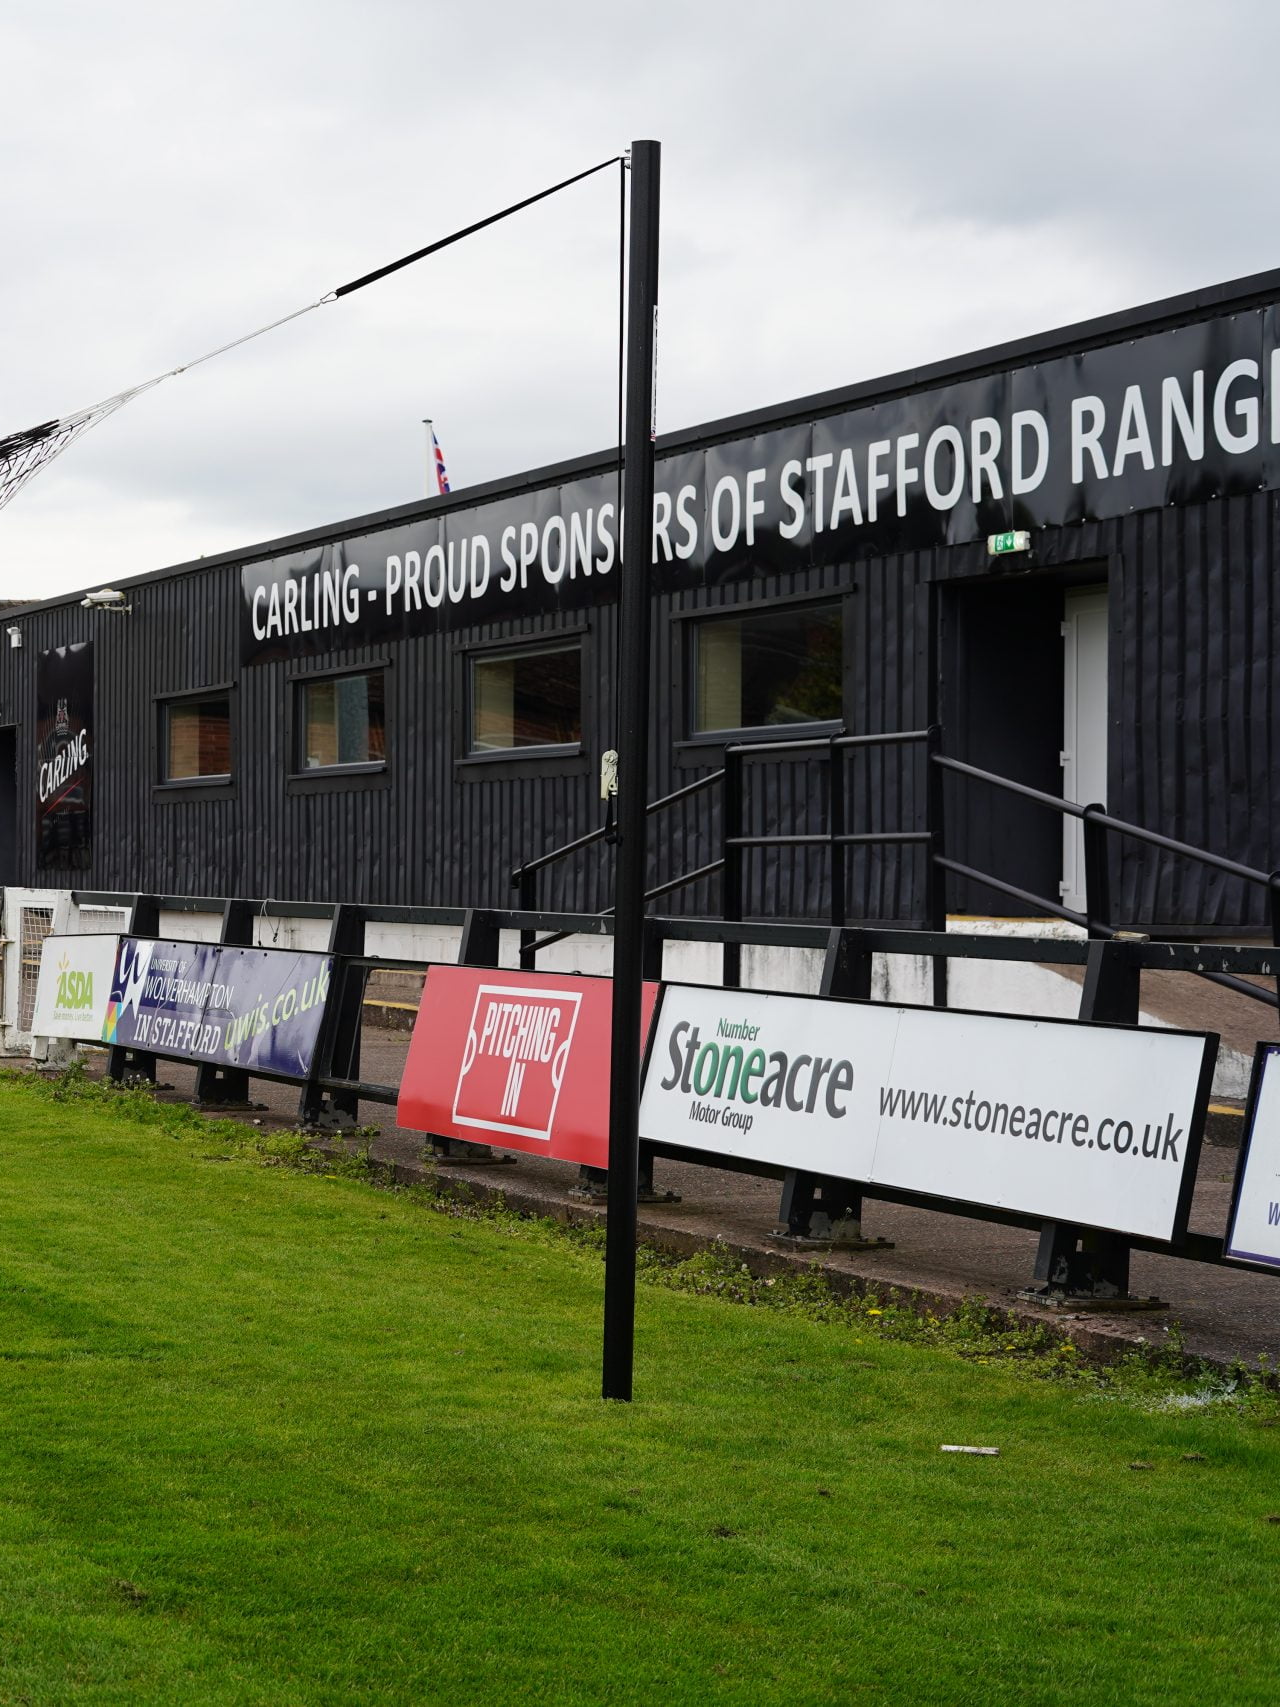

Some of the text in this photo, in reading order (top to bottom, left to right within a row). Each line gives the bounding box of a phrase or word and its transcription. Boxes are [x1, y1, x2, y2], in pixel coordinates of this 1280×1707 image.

[252, 564, 360, 641] CARLING
[368, 590, 376, 601] -
[386, 534, 491, 615] PROUD
[500, 484, 698, 593] SPONSRS
[711, 467, 766, 551] OF
[779, 409, 1049, 539] STAFFORD
[40, 728, 87, 803] CARLING
[55, 970, 93, 1010] ASDA
[144, 976, 235, 1010] WOLVERHAMPTON
[151, 958, 187, 973] UNIVERSITY OF
[223, 960, 330, 1051] uwis.co.uk
[478, 1001, 561, 1064] PITCHING
[716, 1017, 761, 1042] Number
[133, 1013, 221, 1055] IN STAFFORD
[500, 1062, 526, 1118] IN
[660, 1020, 854, 1119] Stoneacre
[688, 1101, 754, 1135] Motor Group
[879, 1086, 1184, 1162] www.stoneacre.co.uk
